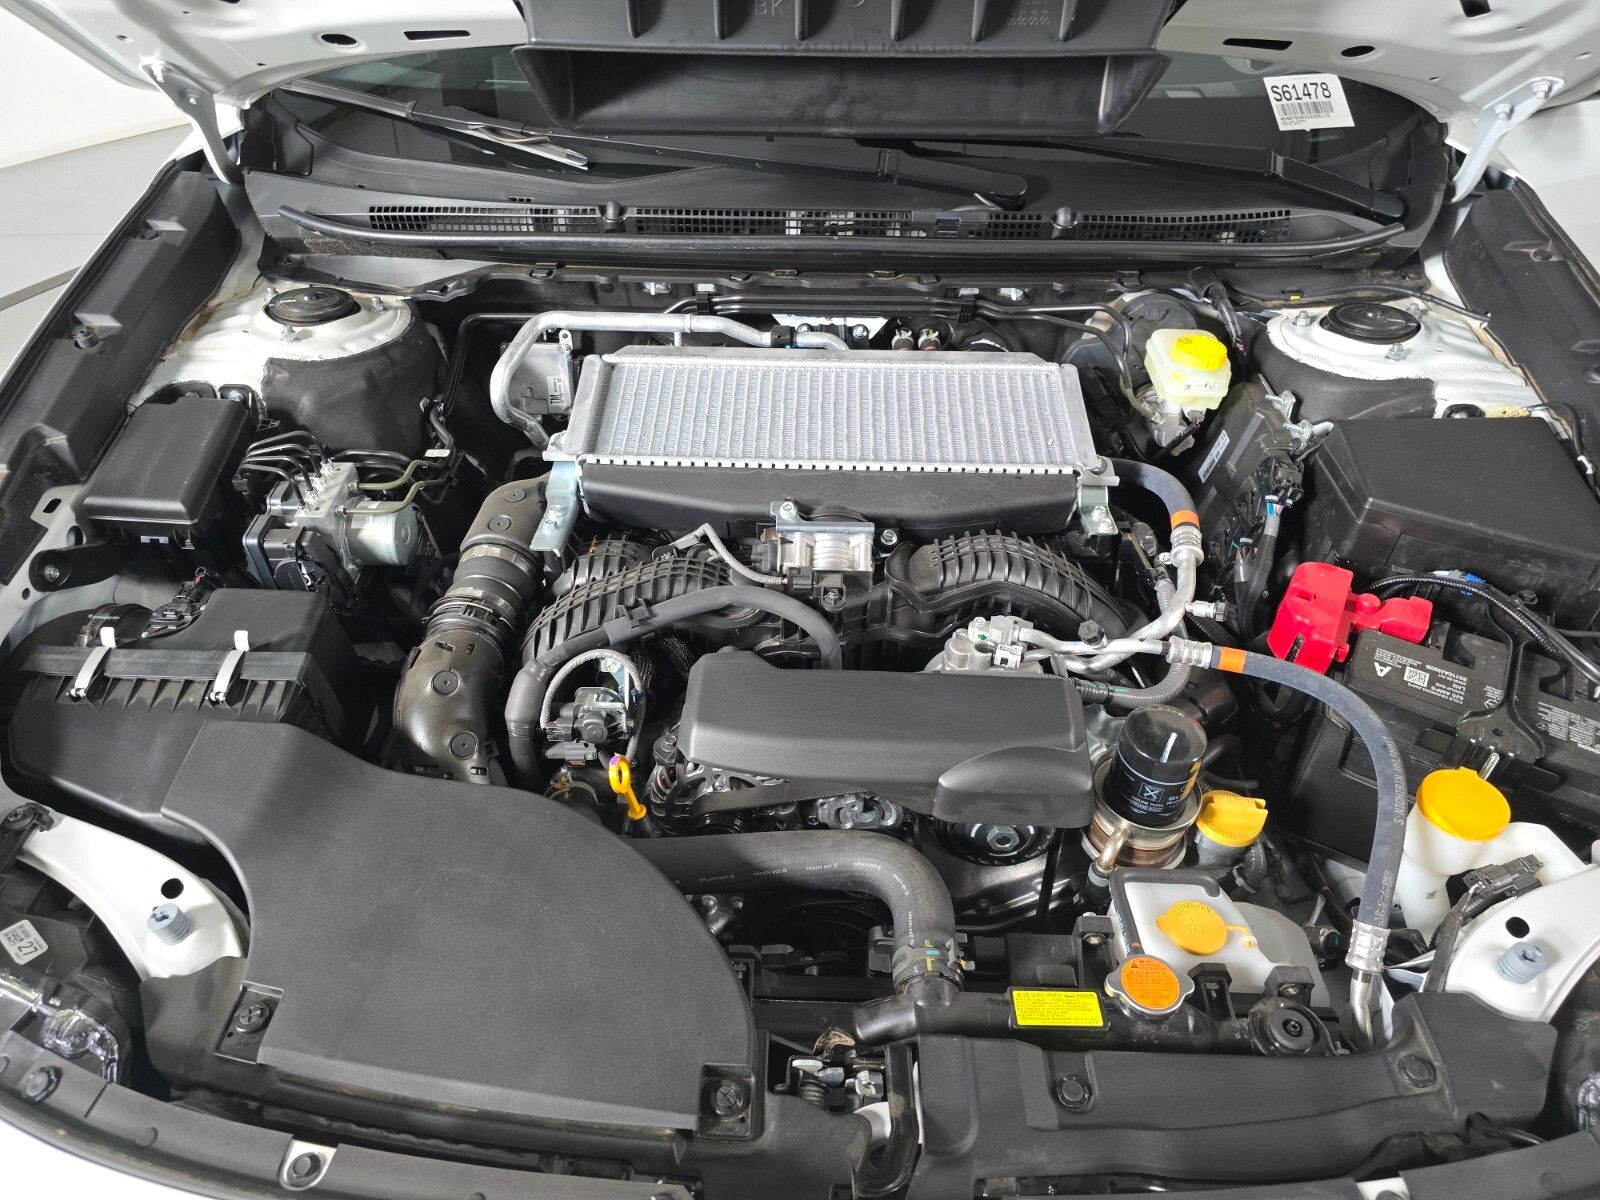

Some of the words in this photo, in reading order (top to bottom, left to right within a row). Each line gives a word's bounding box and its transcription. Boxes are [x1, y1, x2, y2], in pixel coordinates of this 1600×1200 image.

[1270, 82, 1332, 102] S61478
[550, 394, 561, 404] TM
[18, 941, 38, 955] 27
